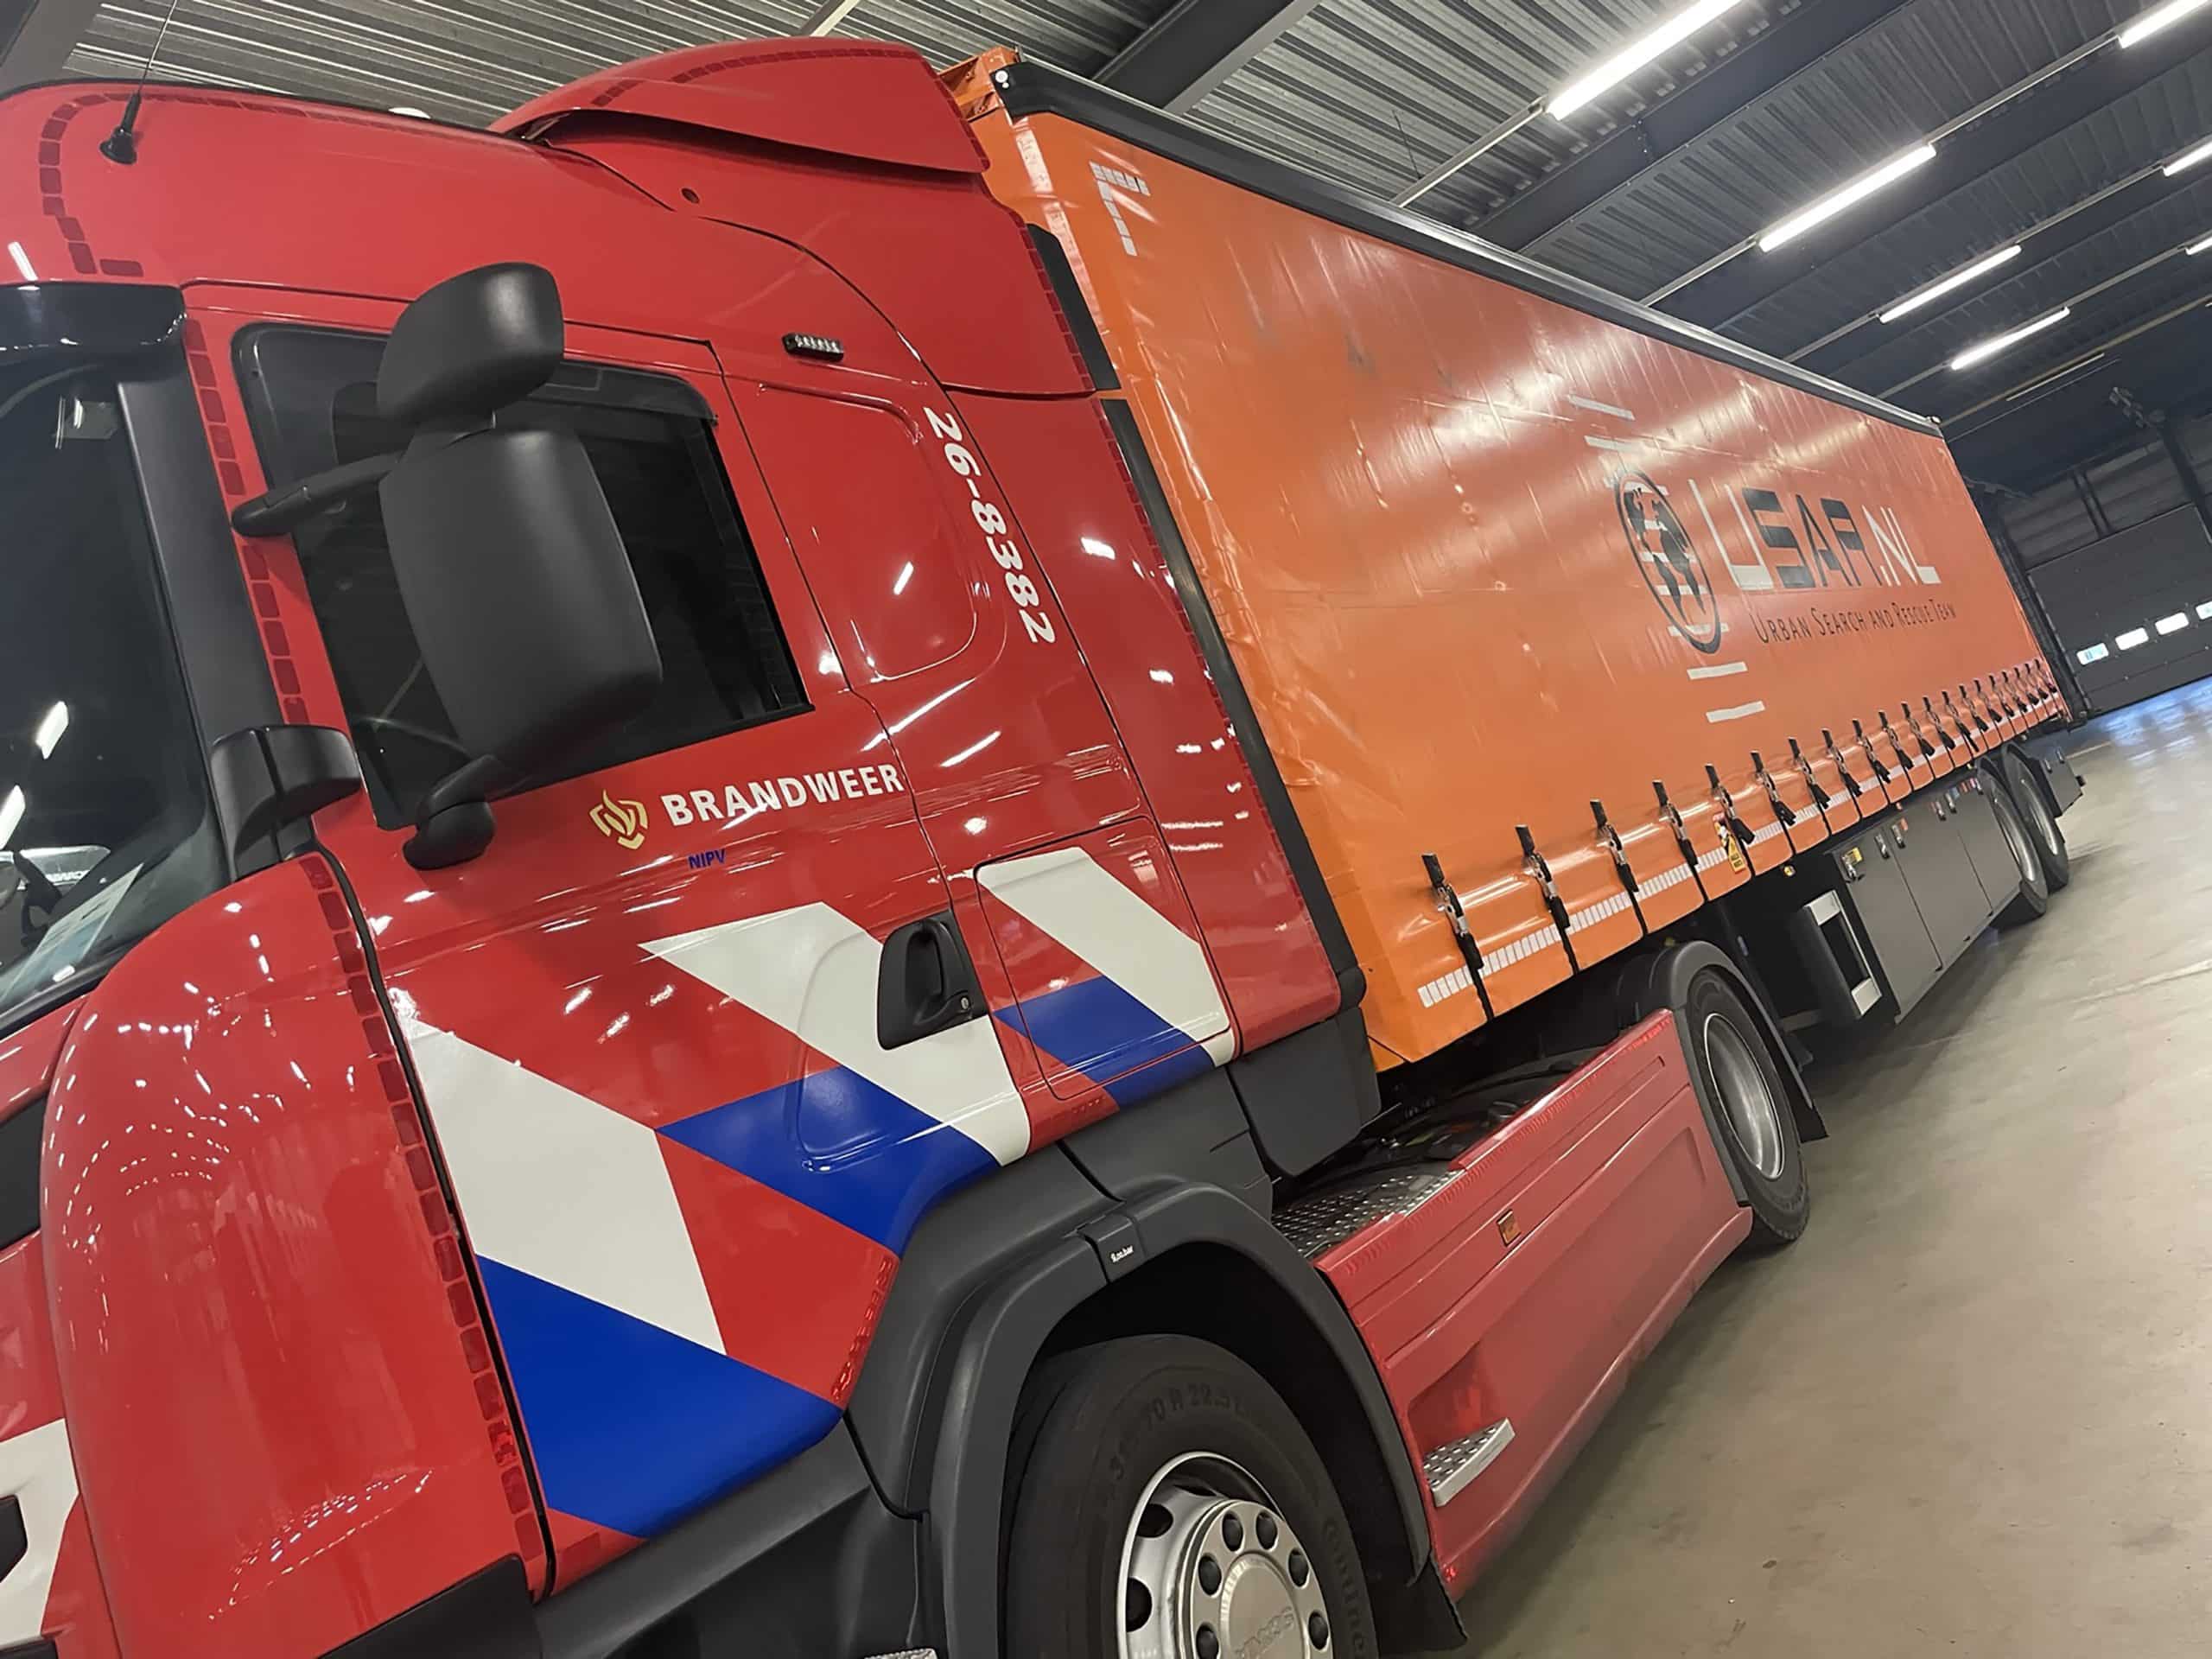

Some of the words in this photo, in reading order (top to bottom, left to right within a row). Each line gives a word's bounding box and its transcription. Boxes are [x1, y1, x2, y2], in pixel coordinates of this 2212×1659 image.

[923, 406, 1056, 643] 26-8382
[660, 763, 905, 827] BRANDWEER
[688, 849, 727, 869] NIPV
